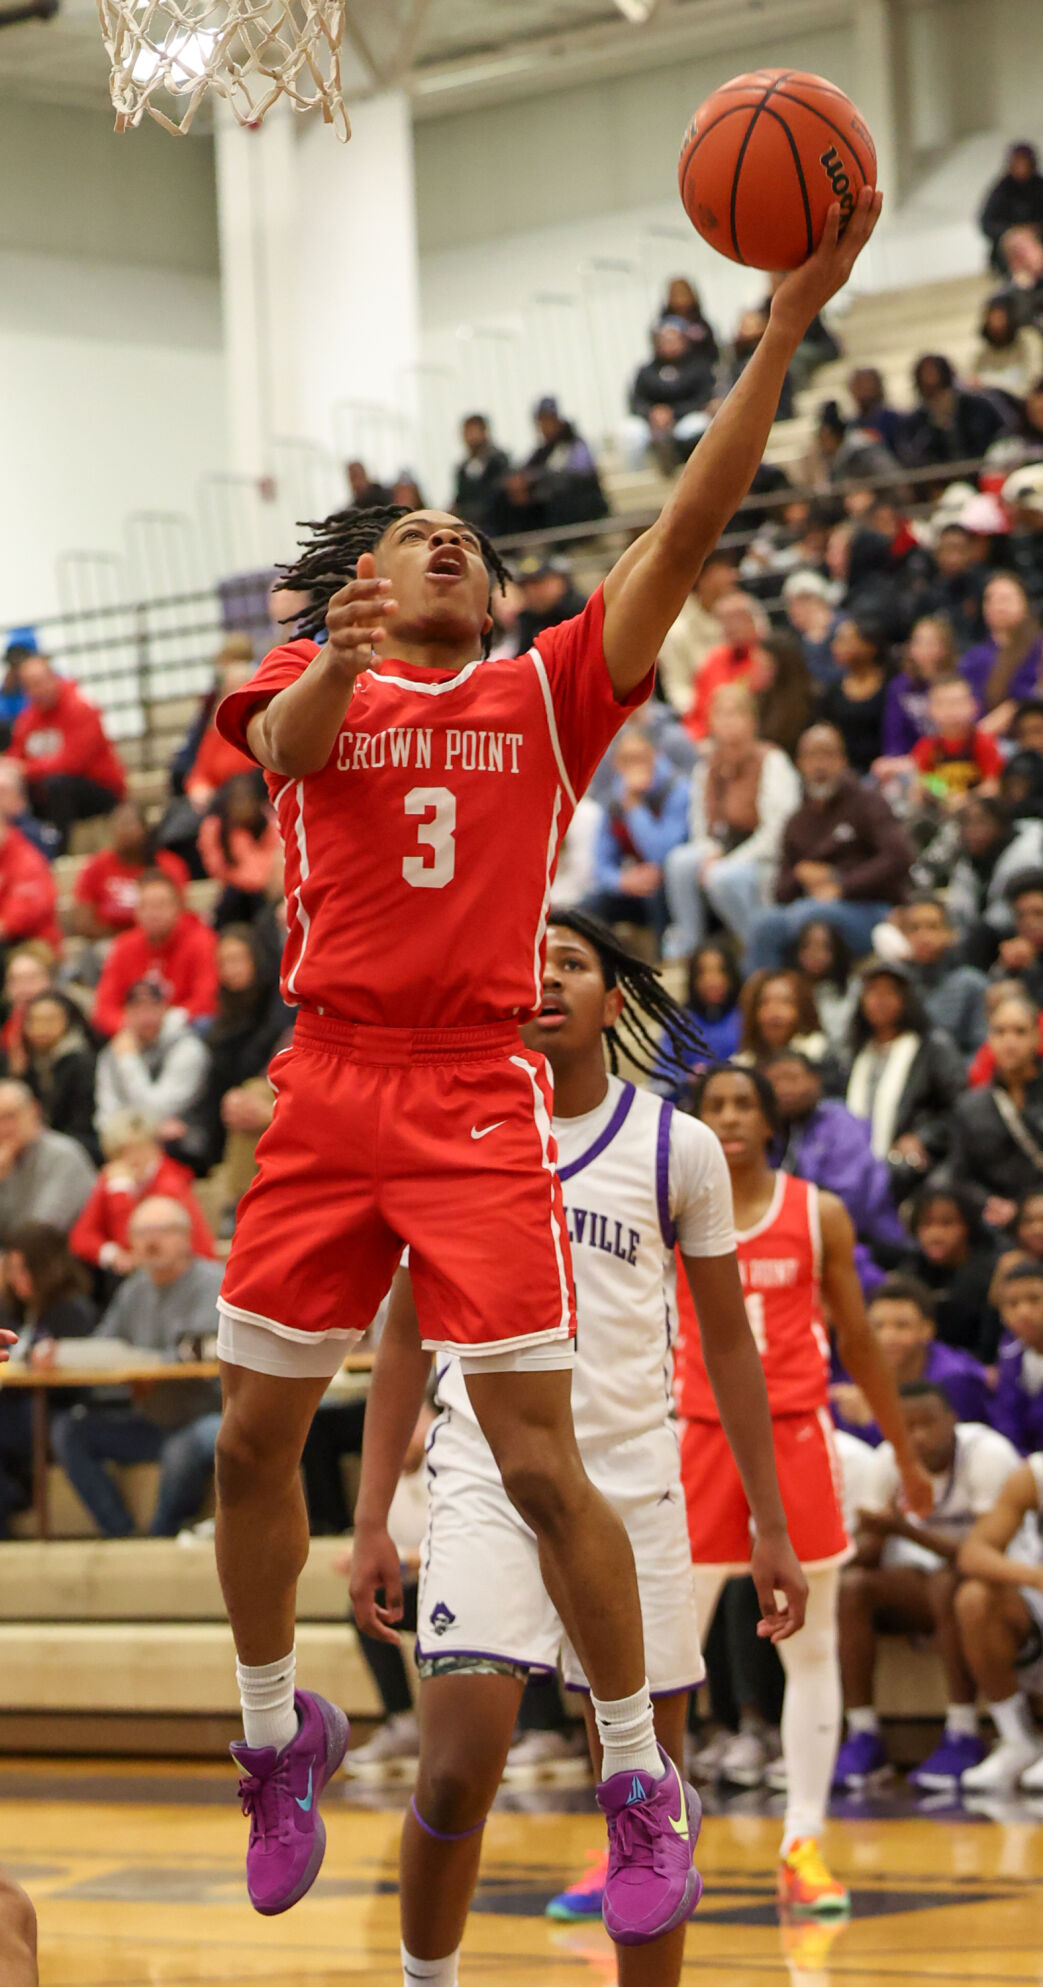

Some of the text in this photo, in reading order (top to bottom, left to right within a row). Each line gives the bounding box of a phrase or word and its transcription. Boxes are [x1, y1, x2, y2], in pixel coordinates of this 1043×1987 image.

[336, 727, 524, 774] CROWN POINT
[402, 786, 457, 889] 3
[563, 1206, 640, 1267] VILLE
